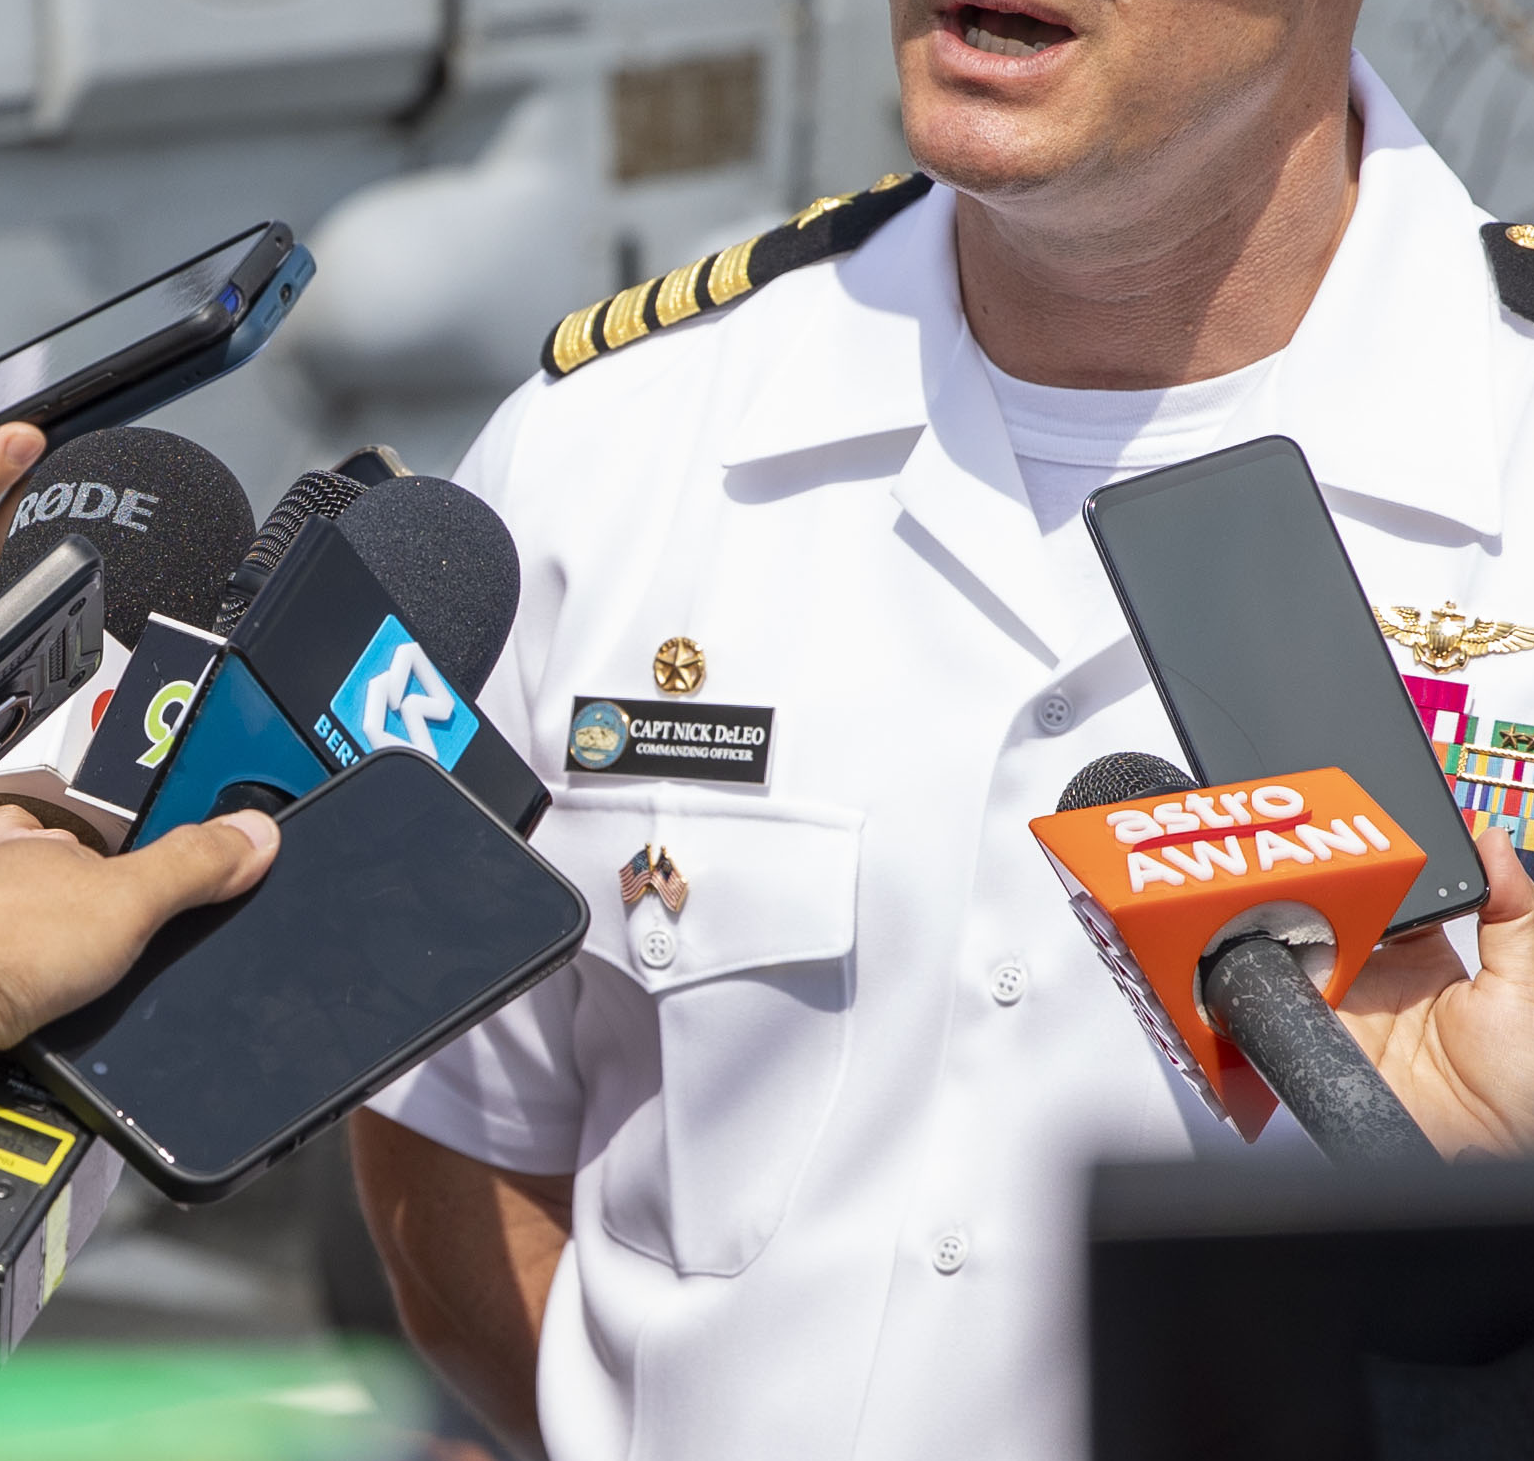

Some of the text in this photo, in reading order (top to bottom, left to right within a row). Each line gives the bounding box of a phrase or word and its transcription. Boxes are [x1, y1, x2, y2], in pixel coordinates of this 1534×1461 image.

[7, 480, 160, 539] RØDE
[135, 679, 198, 769] 9
[630, 719, 765, 745] CAPT NICK DeLEO
[635, 742, 753, 761] COMMANDING OFFICER
[1106, 785, 1305, 845] astro
[1127, 814, 1391, 894] AWANI
